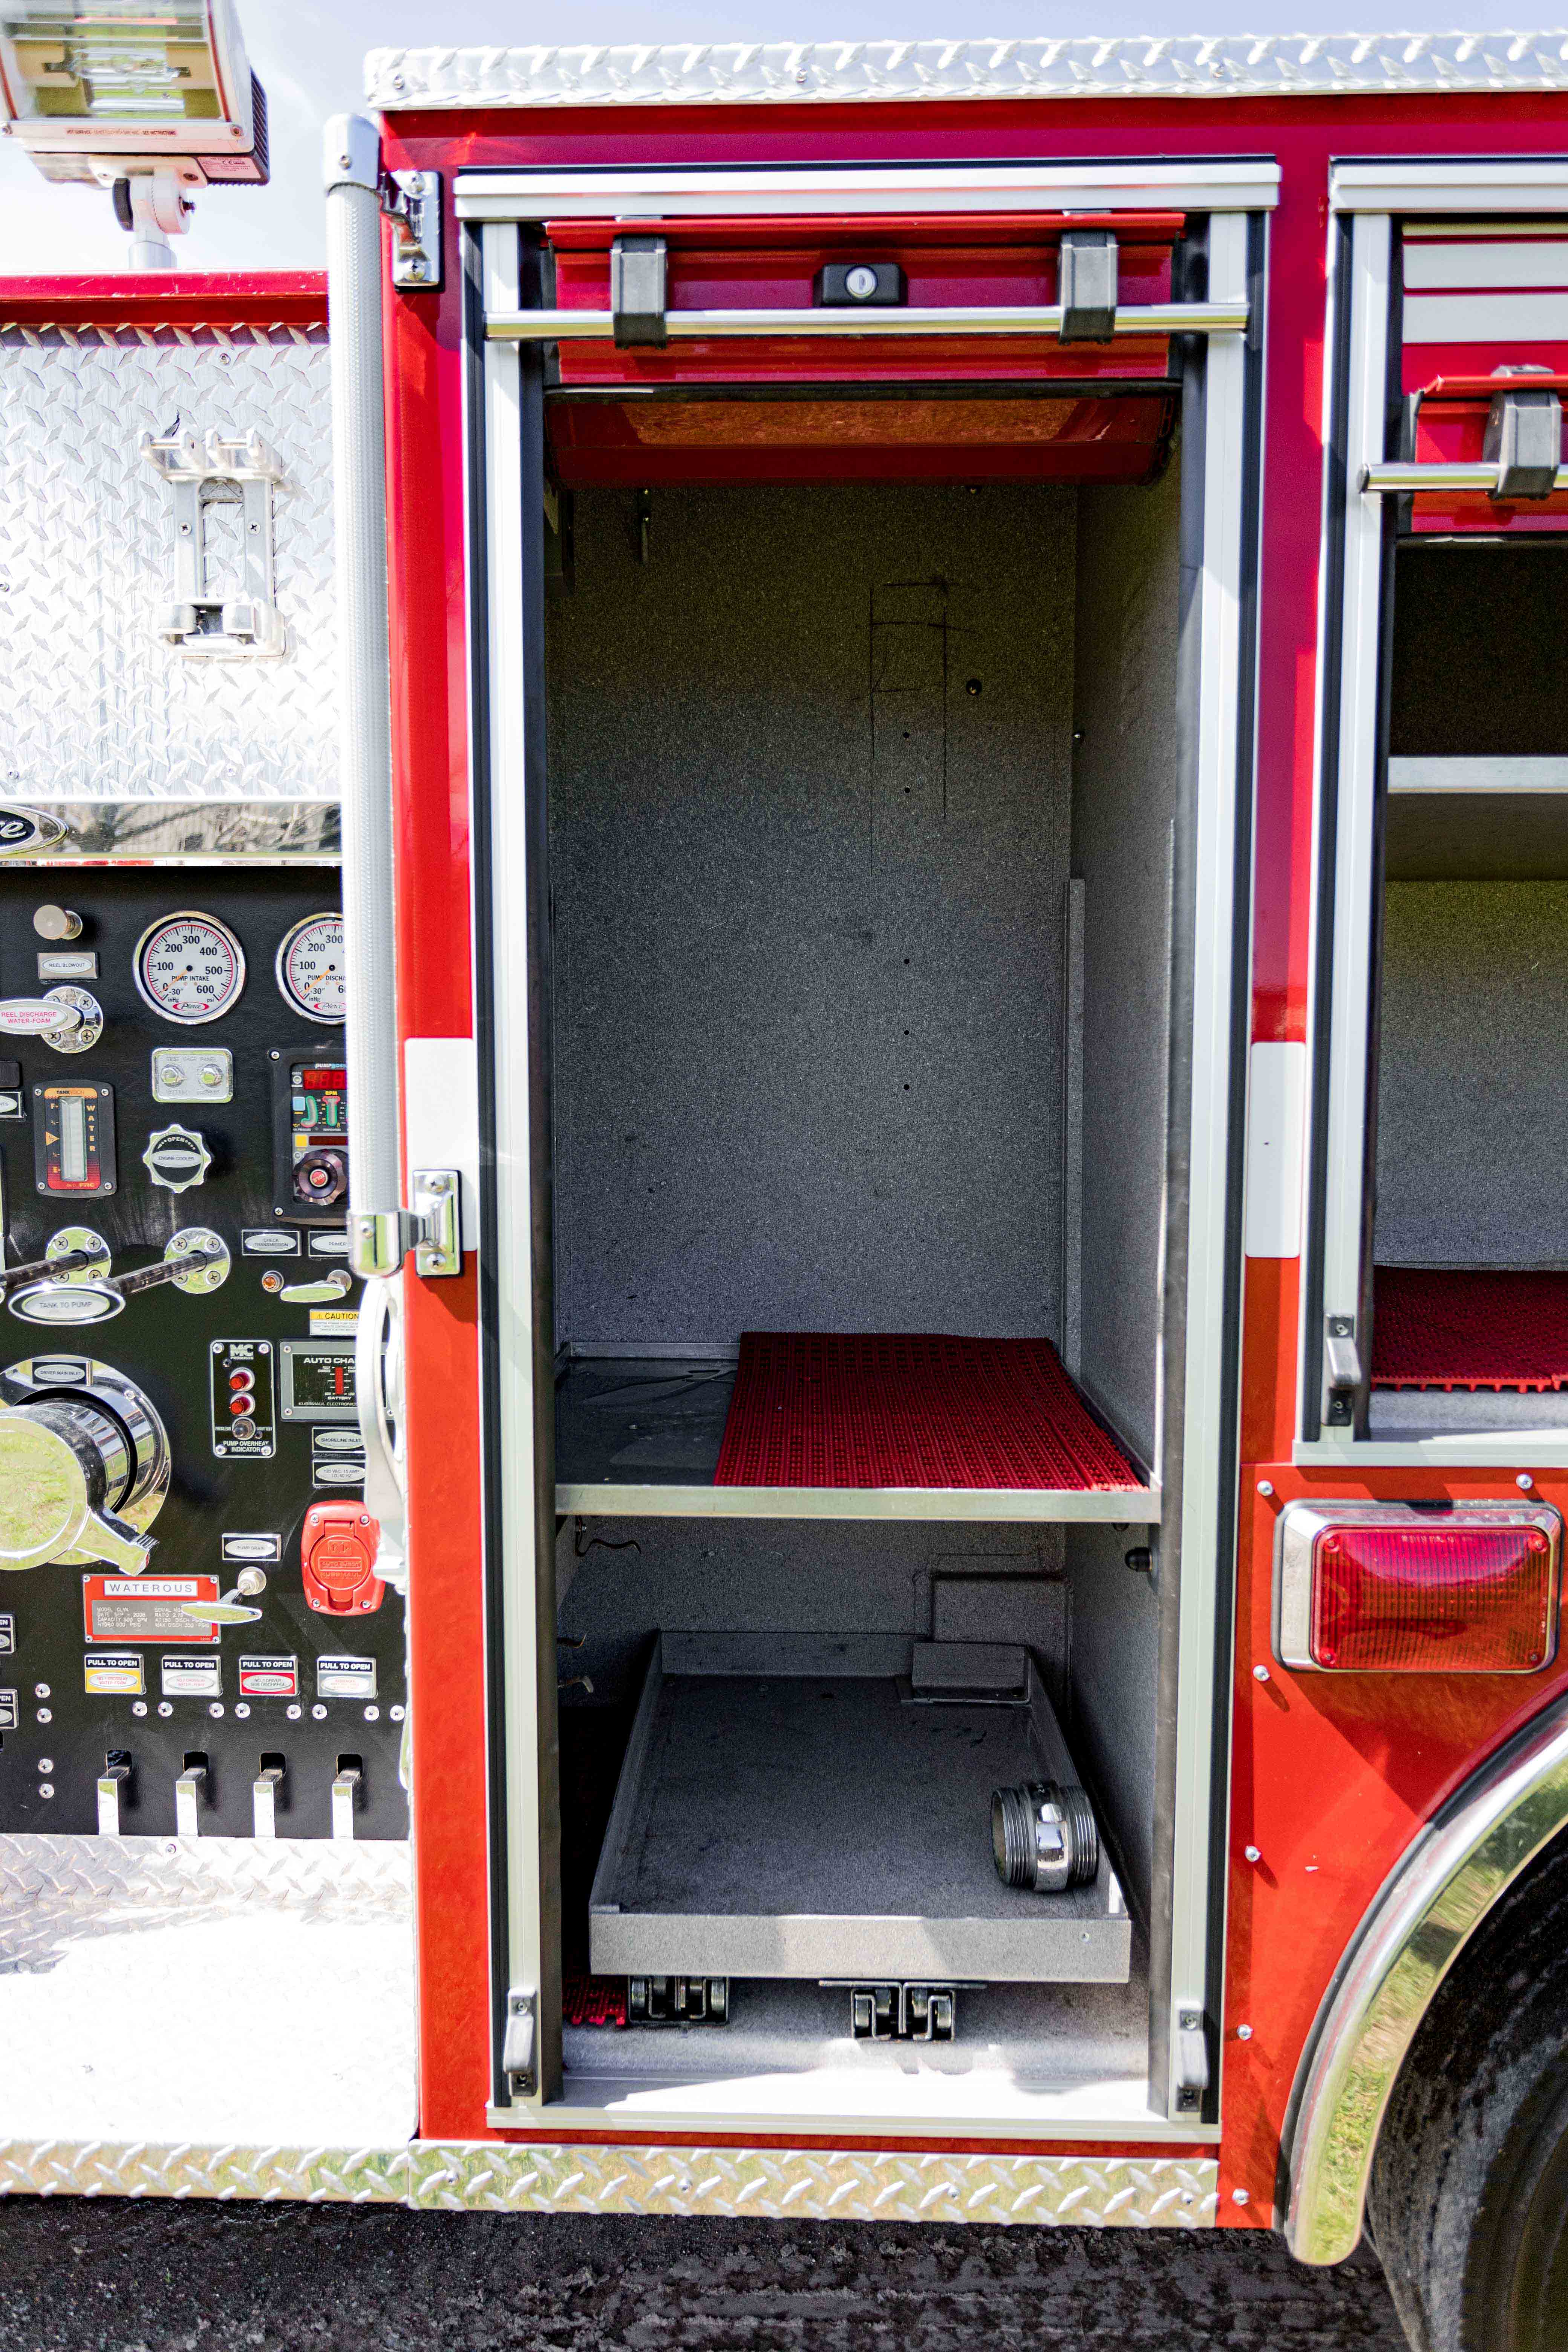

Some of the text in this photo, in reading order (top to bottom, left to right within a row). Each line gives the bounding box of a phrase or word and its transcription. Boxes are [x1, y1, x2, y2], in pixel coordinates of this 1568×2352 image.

[182, 936, 200, 944] 300
[325, 935, 343, 943] 300
[165, 944, 182, 952] 200
[200, 947, 217, 956] 400
[308, 943, 325, 952] 200
[157, 962, 173, 971] 100
[300, 961, 316, 970] 100
[205, 966, 222, 975] 500
[162, 983, 168, 991] 0
[196, 985, 214, 994] 600
[304, 982, 310, 991] 0
[86, 1105, 96, 1152] WATER
[230, 1344, 254, 1356] MC
[110, 1584, 192, 1592] WATEROUS
